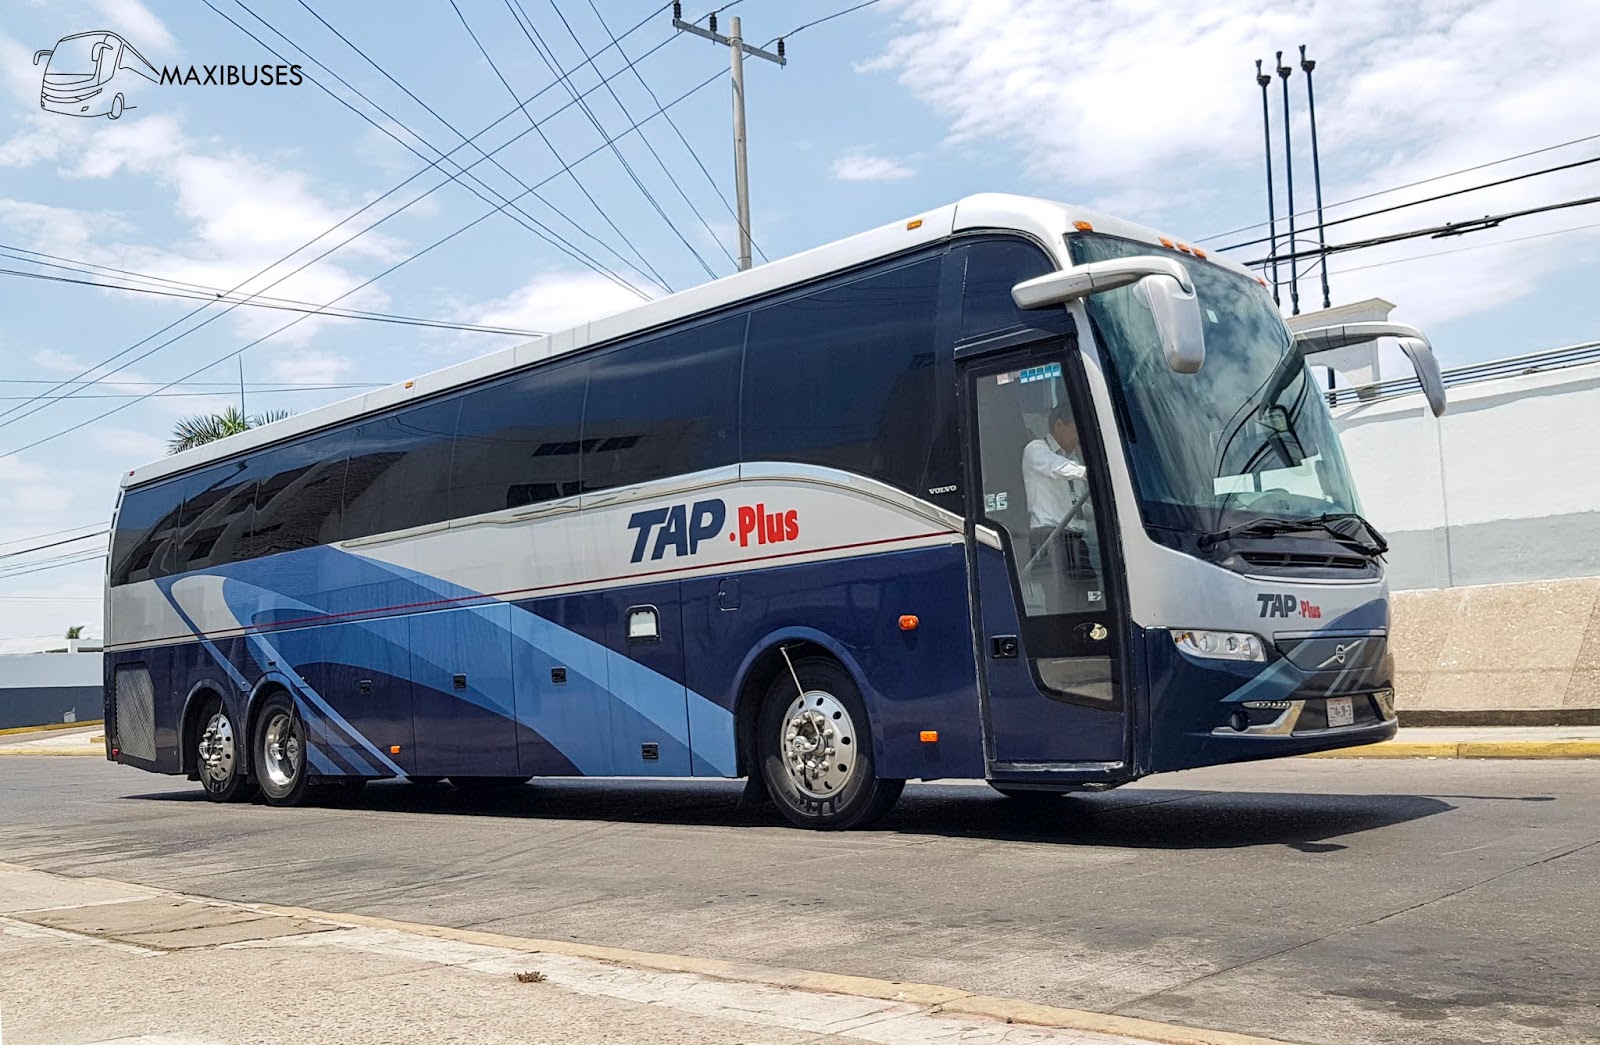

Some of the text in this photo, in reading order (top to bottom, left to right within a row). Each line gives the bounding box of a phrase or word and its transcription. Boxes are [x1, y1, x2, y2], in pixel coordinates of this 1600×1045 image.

[928, 485, 957, 495] VOLVO
[627, 498, 726, 564] TAP
[1256, 593, 1297, 618] TAP
